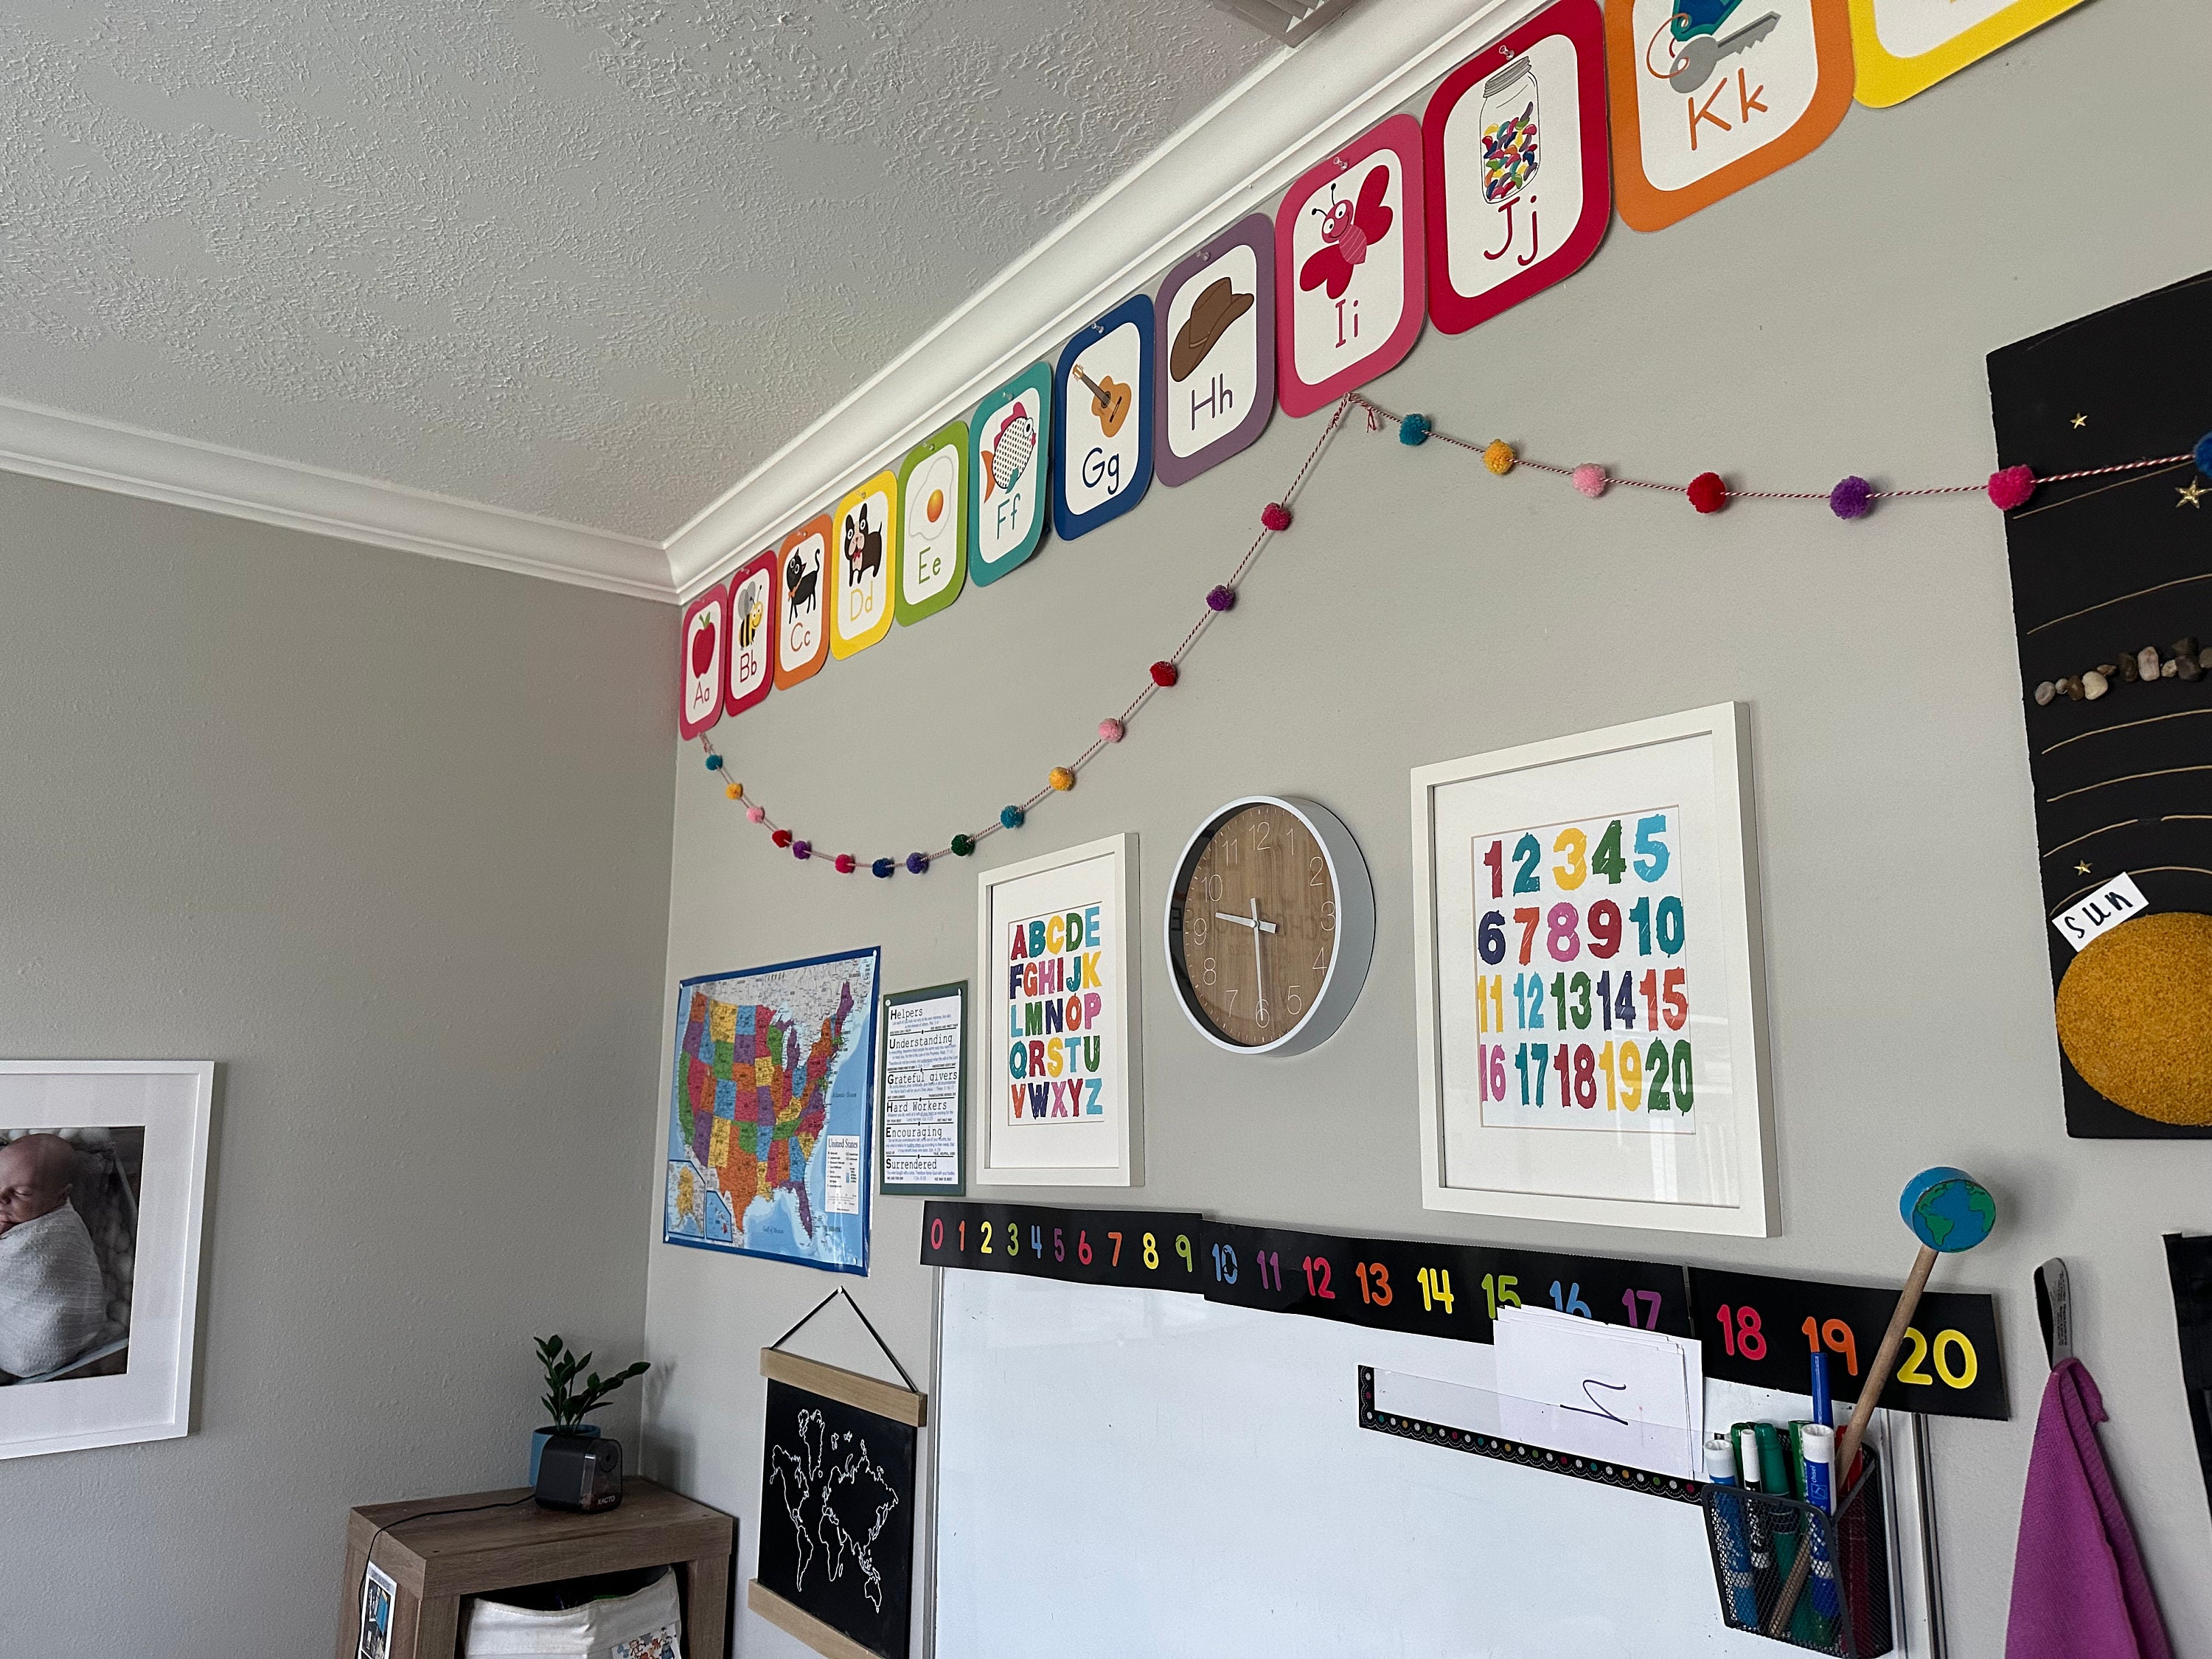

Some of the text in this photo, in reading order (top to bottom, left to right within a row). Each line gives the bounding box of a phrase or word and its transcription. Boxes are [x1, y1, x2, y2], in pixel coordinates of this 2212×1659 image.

[1688, 67, 1768, 150] Kk
[1484, 195, 1539, 266] Jj
[1335, 298, 1359, 349] Ii
[1191, 373, 1234, 431] Hh
[1082, 447, 1121, 495] Gg
[997, 493, 1021, 540] Ff
[919, 546, 942, 584] Ee
[849, 580, 874, 622] Dd
[790, 622, 811, 652] Cc
[740, 653, 758, 684] Bb
[693, 681, 710, 709] Aa
[1248, 821, 1271, 852] 12
[1286, 827, 1295, 856] 1
[1222, 838, 1238, 867] 11
[1484, 813, 1671, 900] 1 2 3 4 5
[1310, 856, 1325, 886] 2
[1200, 874, 1224, 903] 10
[1321, 900, 1336, 931] 3
[1478, 895, 1686, 966] 6 7 8 9 10
[2064, 891, 2134, 939] sun
[1193, 917, 1208, 946] 9
[1203, 957, 1217, 986] 8
[1311, 946, 1328, 976] 4
[890, 1008, 923, 1020] Helpers
[1225, 989, 1239, 1018] 7
[1255, 998, 1270, 1029] 6
[1286, 984, 1302, 1015] 5
[1477, 966, 1688, 1033] 11 12 13 14 15
[889, 1033, 953, 1049] Understanding
[887, 1071, 958, 1085] Grateful givers
[1480, 1037, 1694, 1116] 16 17 18 19 20
[886, 1100, 947, 1113] Hard Workers
[828, 1138, 858, 1148] United States
[886, 1126, 942, 1139] Encouraging
[886, 1158, 937, 1169] Surrendered
[931, 1218, 1978, 1390] 0 1 2 3 4 5 6 7 8 9 10 11 12 13 14 15 16 17 18 19 20
